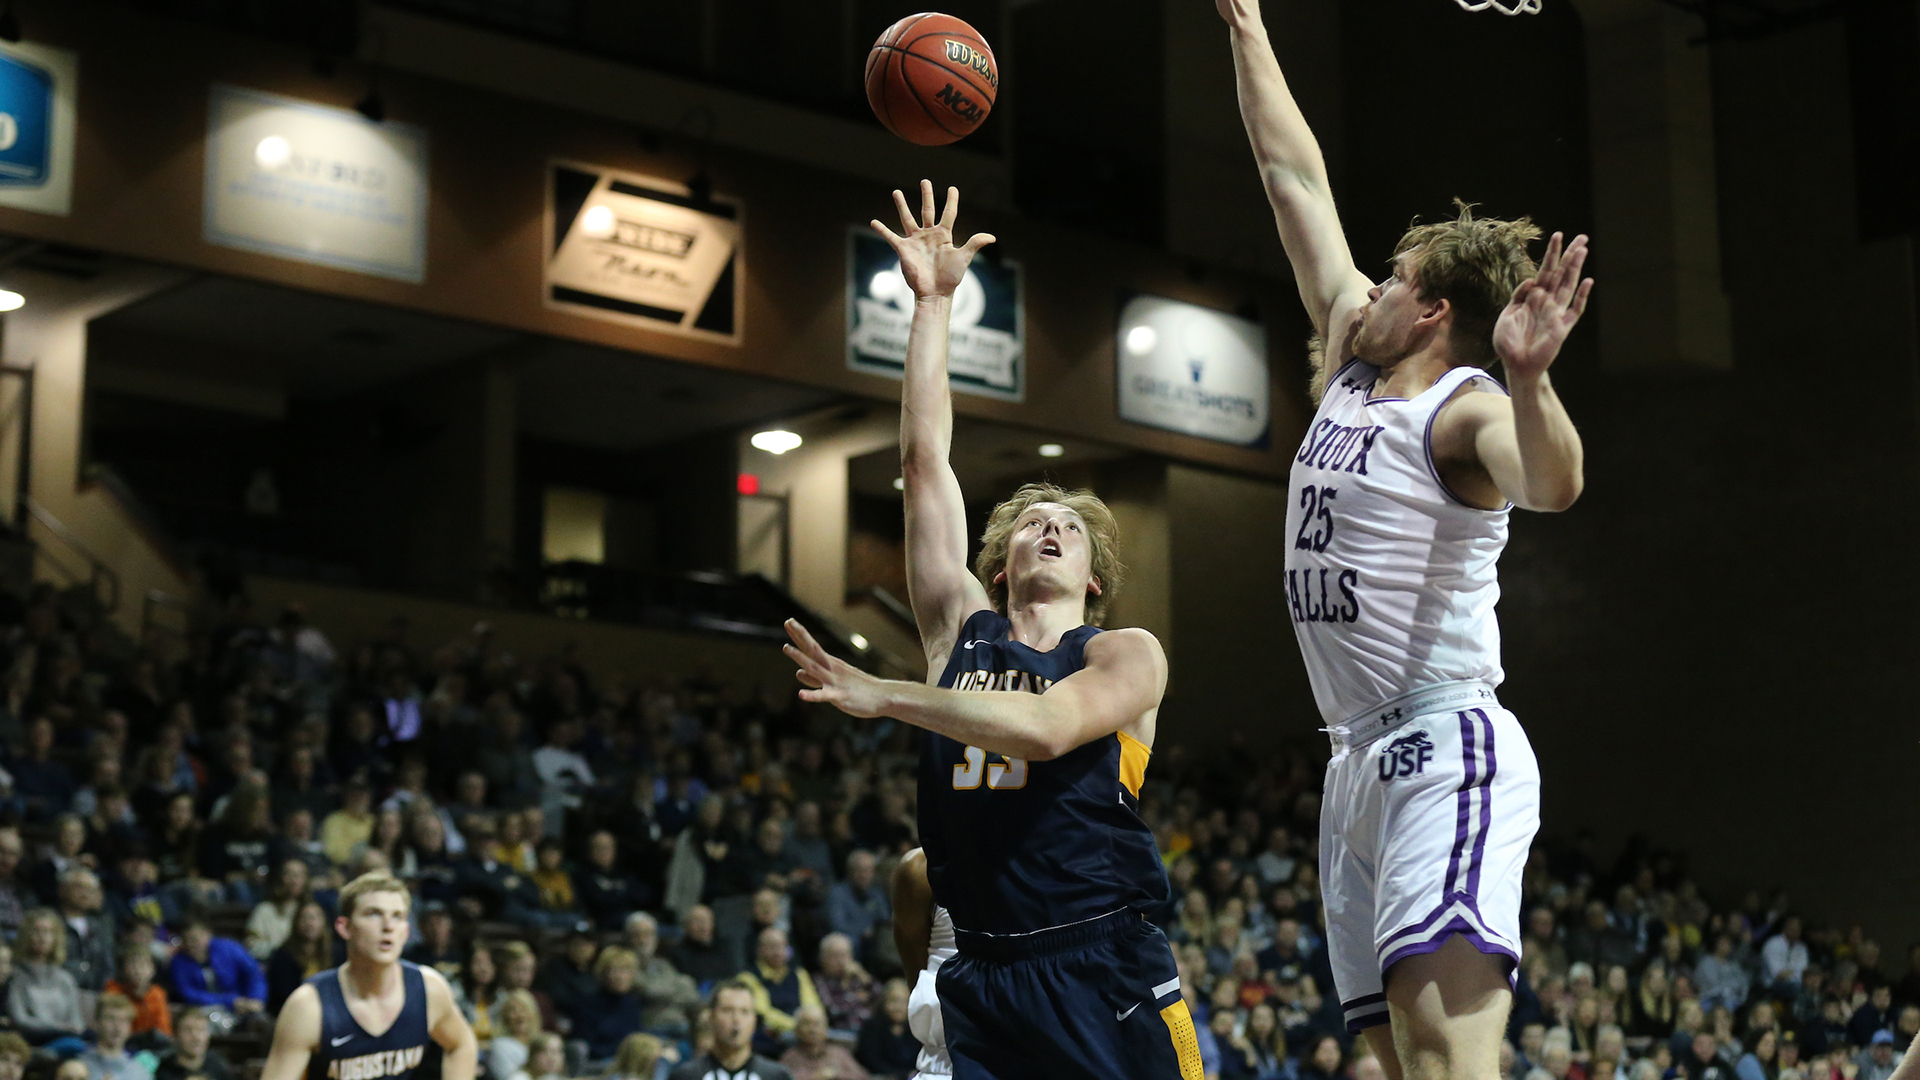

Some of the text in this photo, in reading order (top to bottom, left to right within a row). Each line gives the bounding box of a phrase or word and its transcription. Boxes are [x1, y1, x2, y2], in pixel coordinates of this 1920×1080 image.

[945, 39, 998, 92] Wilso
[936, 83, 985, 124] NCAA
[1297, 418, 1385, 476] SIOUX
[1295, 485, 1338, 553] 25
[1284, 568, 1359, 622] ALLS
[1379, 743, 1434, 782] USF
